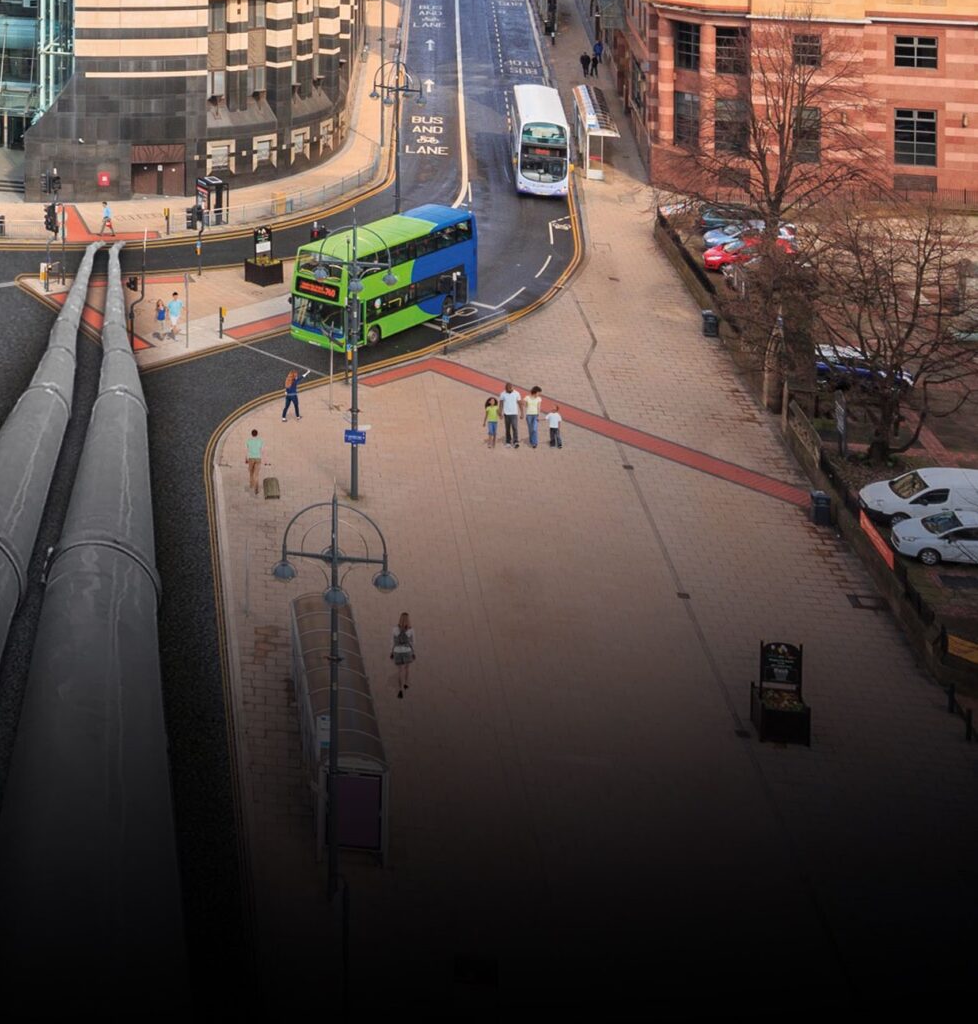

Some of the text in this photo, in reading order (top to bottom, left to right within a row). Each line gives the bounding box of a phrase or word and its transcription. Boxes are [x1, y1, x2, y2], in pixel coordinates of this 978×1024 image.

[411, 115, 444, 124] BUS
[412, 125, 444, 134] AND
[405, 145, 449, 155] LANE
